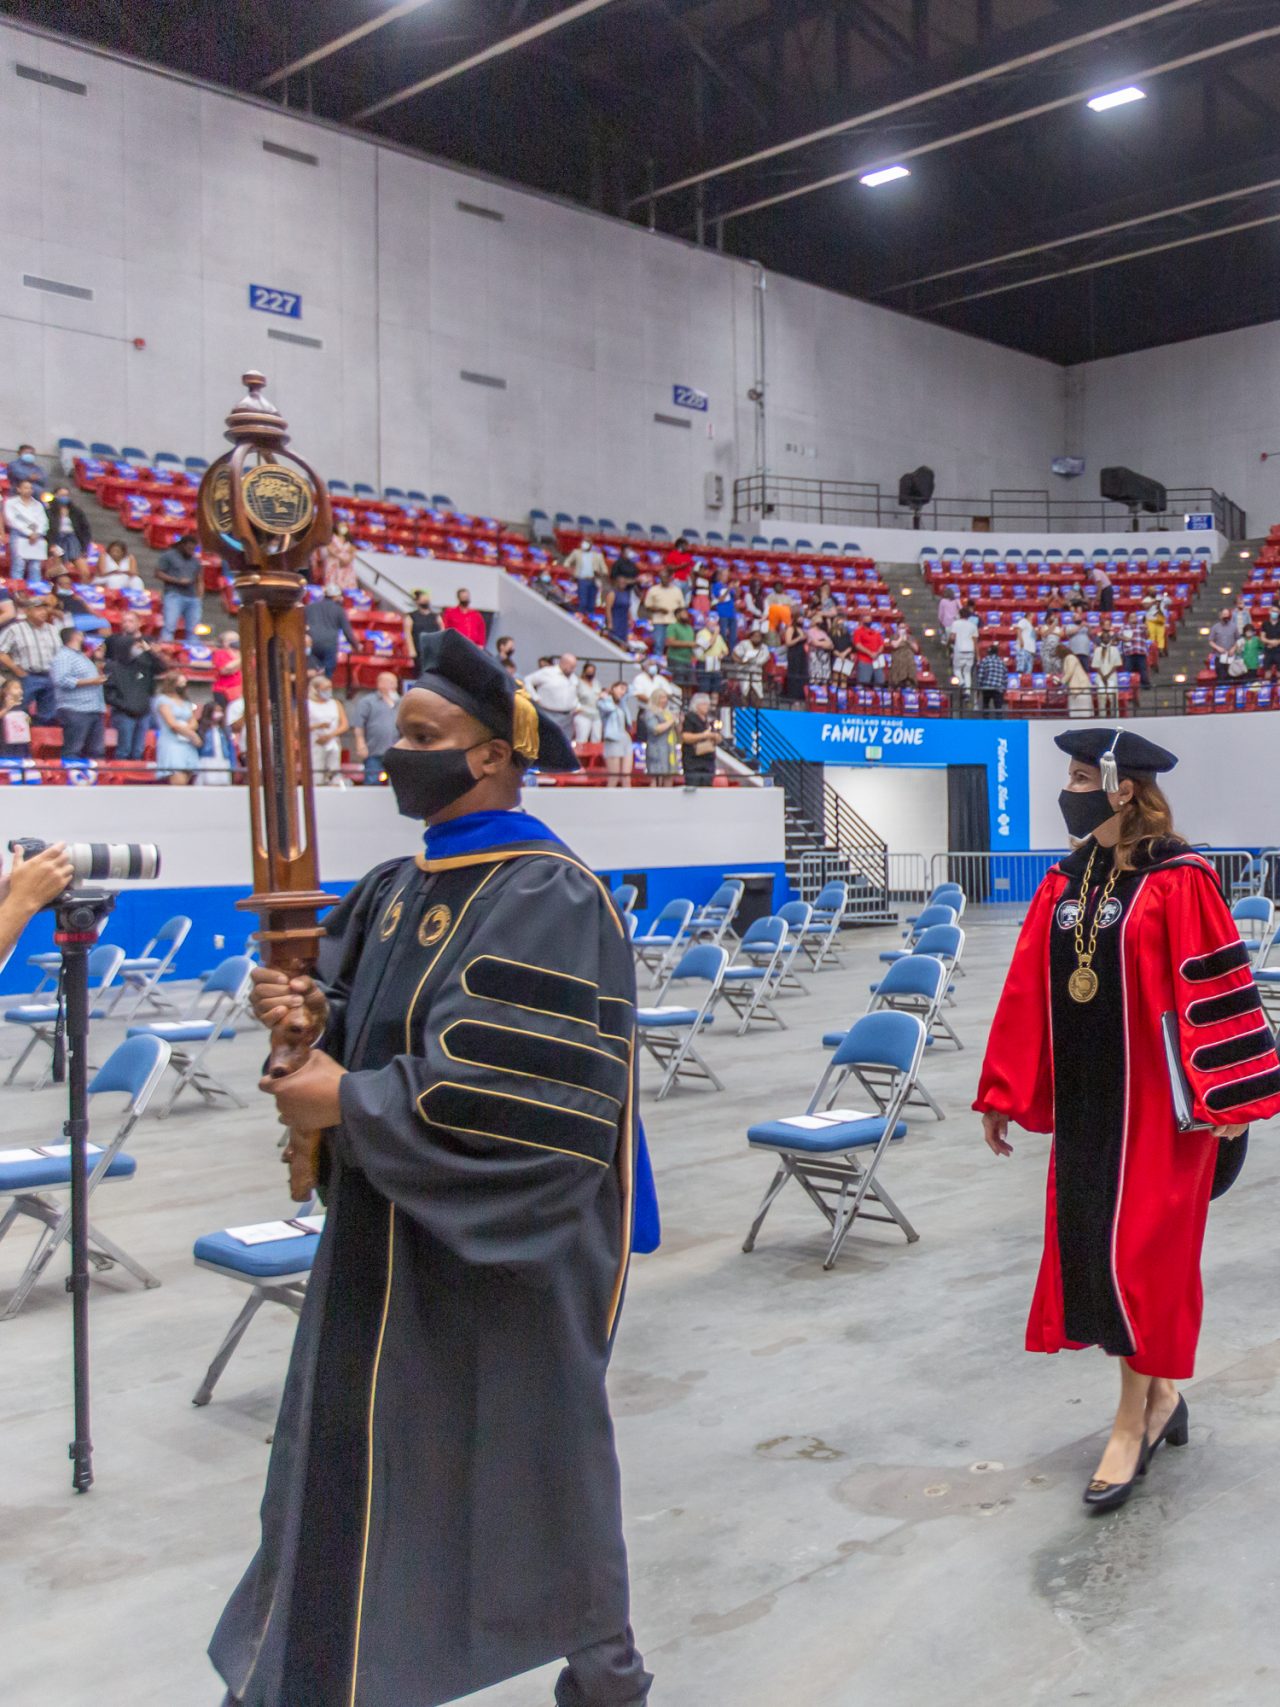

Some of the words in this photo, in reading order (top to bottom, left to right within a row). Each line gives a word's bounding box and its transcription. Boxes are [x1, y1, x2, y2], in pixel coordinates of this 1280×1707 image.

[255, 289, 296, 313] 227
[821, 724, 879, 744] FAMILY
[882, 728, 925, 745] ZONE
[842, 718, 879, 726] LAKELAND
[881, 719, 903, 727] MAGIC
[997, 737, 1008, 783] Florida
[998, 784, 1009, 810] Blue
